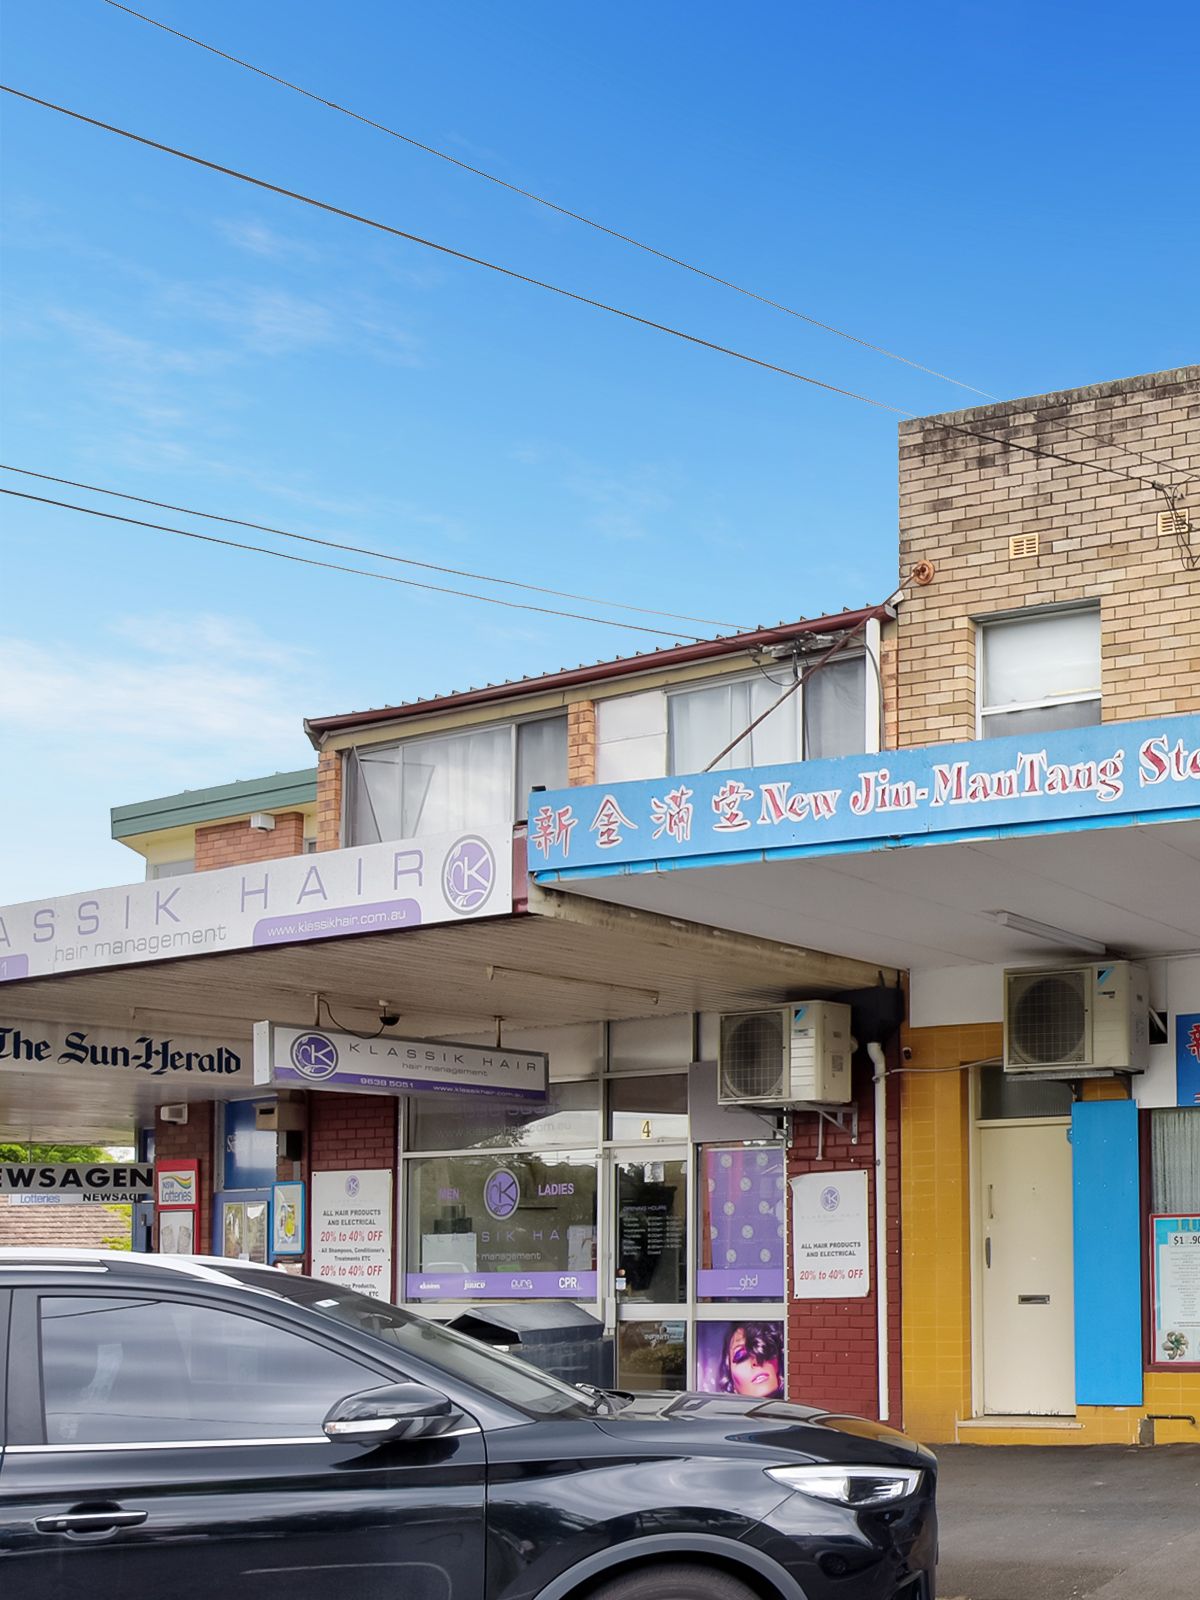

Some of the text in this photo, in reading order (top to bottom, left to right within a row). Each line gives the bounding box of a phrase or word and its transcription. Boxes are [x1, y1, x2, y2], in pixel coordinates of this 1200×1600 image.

[757, 782, 842, 824] New
[850, 749, 1125, 816] Jin-ManTang
[241, 850, 424, 912] HAIR
[267, 909, 406, 937] www.klassikhair.com.au
[54, 924, 226, 962] hair management
[0, 1027, 241, 1075] The Sun-Herald
[349, 1043, 537, 1072] KLASSIK HAIR
[402, 1062, 488, 1078] hair management
[360, 1077, 387, 1087] 9638
[642, 1121, 651, 1138] 4
[0, 1168, 153, 1188] WSAGEN
[20, 1193, 61, 1204] Lotteries
[161, 1190, 192, 1202] Lotteries
[439, 1183, 575, 1201] MEN LADIES
[322, 1209, 333, 1217] ALL
[350, 1208, 381, 1216] PRODUCTS
[341, 1218, 376, 1226] ELECTRICAL
[320, 1230, 383, 1242] 20% to 40% OFF
[481, 1252, 542, 1261] management
[320, 1265, 383, 1276] 20% to 40% OFF
[800, 1269, 864, 1280] 20% to 40% OFF
[559, 1277, 577, 1289] CPR
[739, 1273, 758, 1291] ghd
